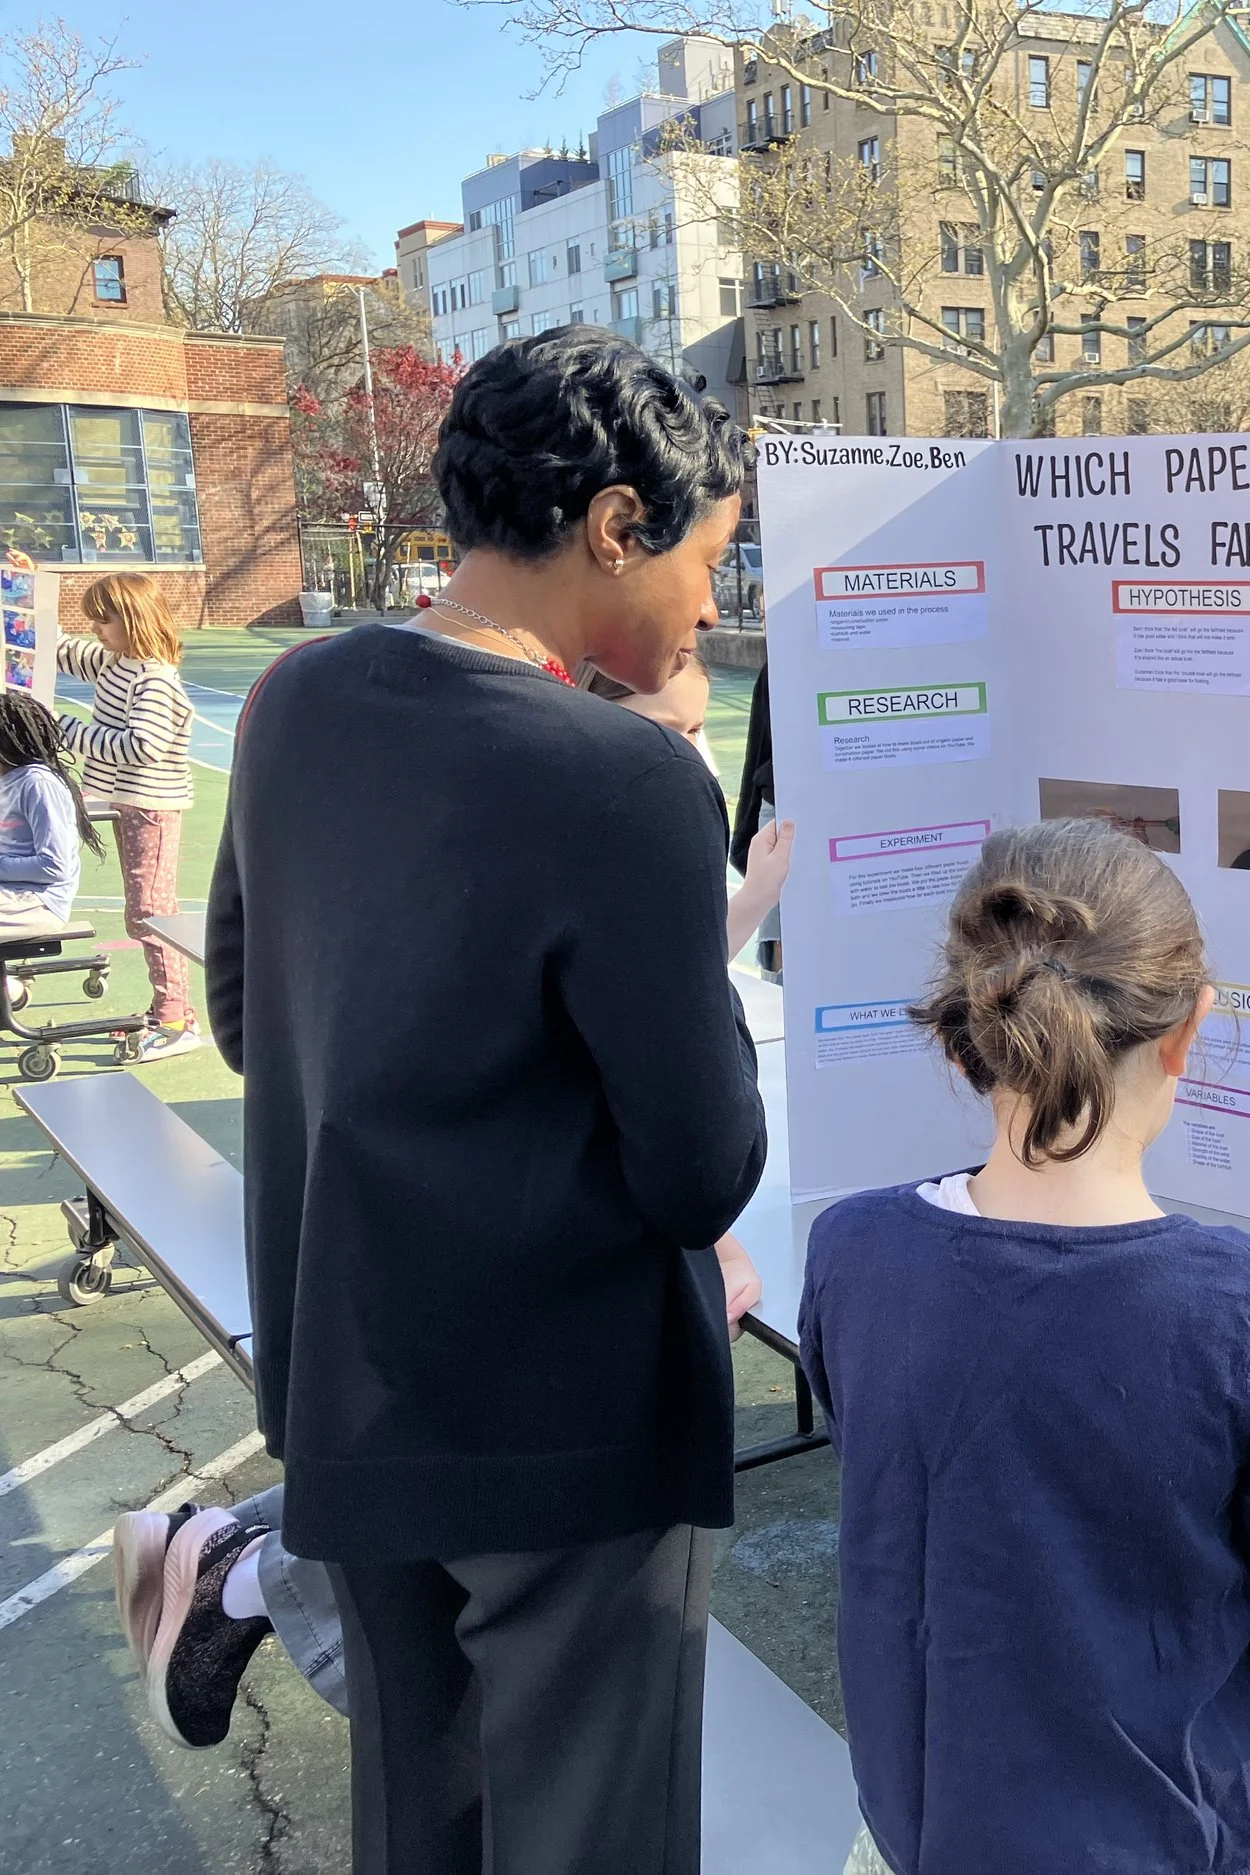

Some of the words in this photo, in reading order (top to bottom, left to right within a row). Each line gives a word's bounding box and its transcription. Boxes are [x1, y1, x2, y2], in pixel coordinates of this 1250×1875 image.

[1014, 451, 1131, 498] WHICH
[1033, 521, 1181, 568] TRAVELS
[844, 570, 957, 592] MATERIALS
[1129, 588, 1242, 608] HYPOTHESIS
[829, 610, 863, 618] Materials
[878, 608, 896, 616] used
[920, 606, 949, 615] process
[848, 691, 958, 716] RESEARCH
[834, 736, 870, 744] Research
[880, 832, 944, 848] EXPERIMENT
[850, 1010, 878, 1020] WHAT
[880, 1008, 896, 1018] WE
[1186, 1088, 1236, 1107] VARIABLES
